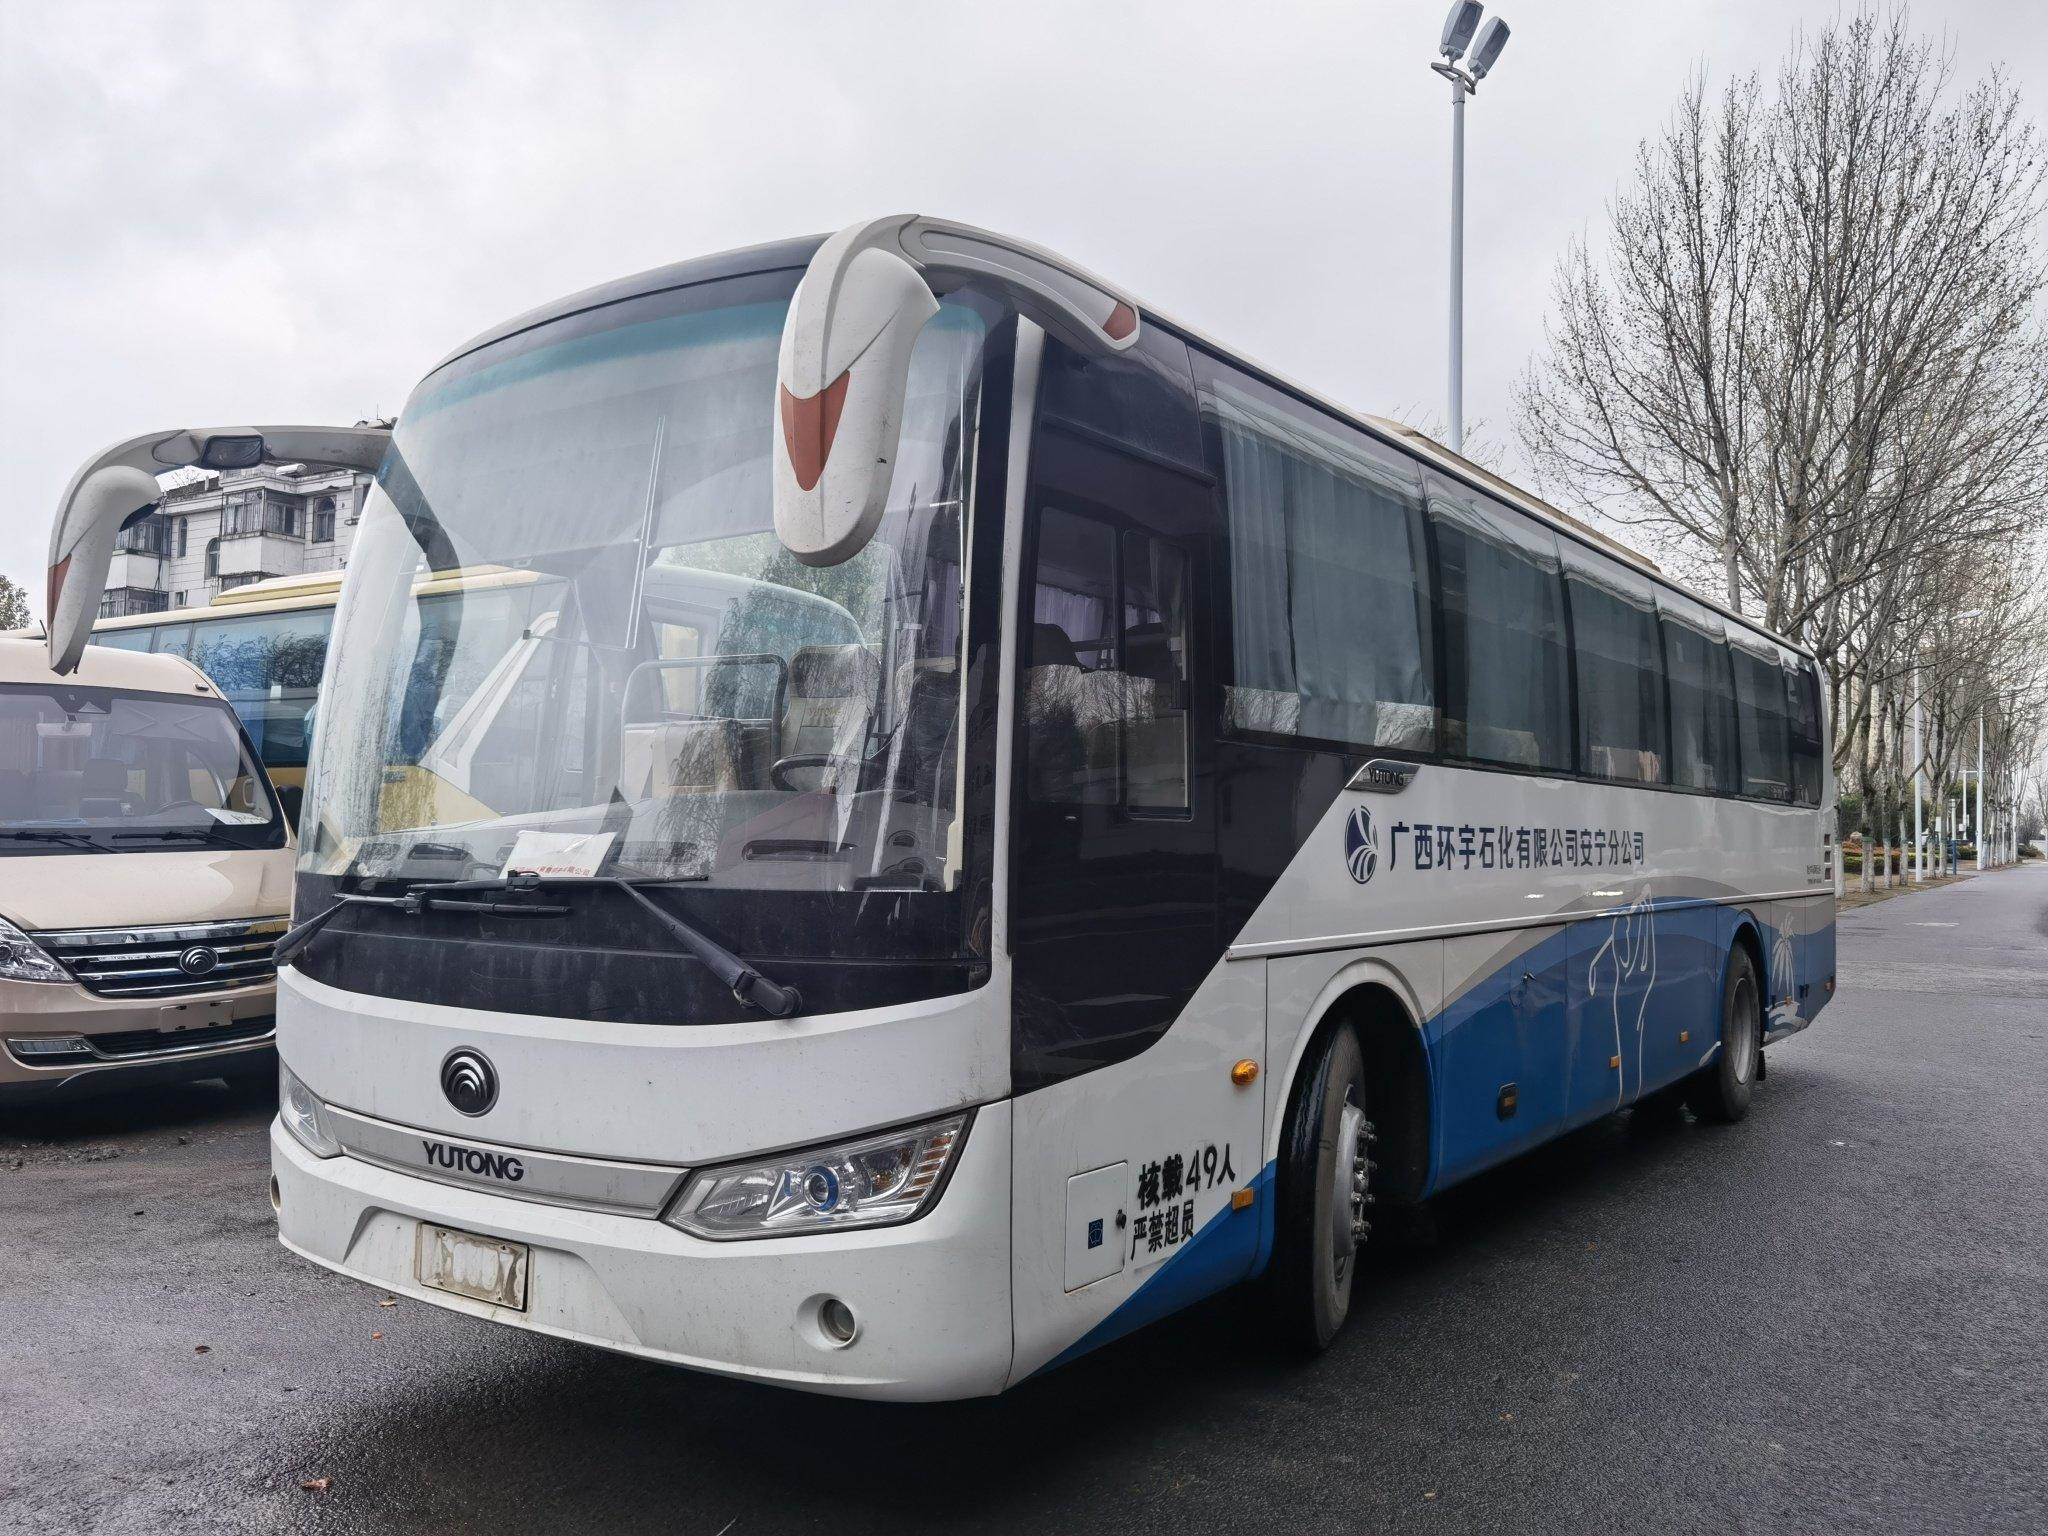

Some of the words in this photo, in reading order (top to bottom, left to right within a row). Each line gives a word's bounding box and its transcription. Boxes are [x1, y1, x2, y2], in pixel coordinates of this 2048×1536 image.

[1390, 821, 1644, 871] 广西环宇石化有限公司安宁分公司
[422, 1140, 524, 1181] YUTONG
[1130, 1199, 1194, 1261] 严禁超员
